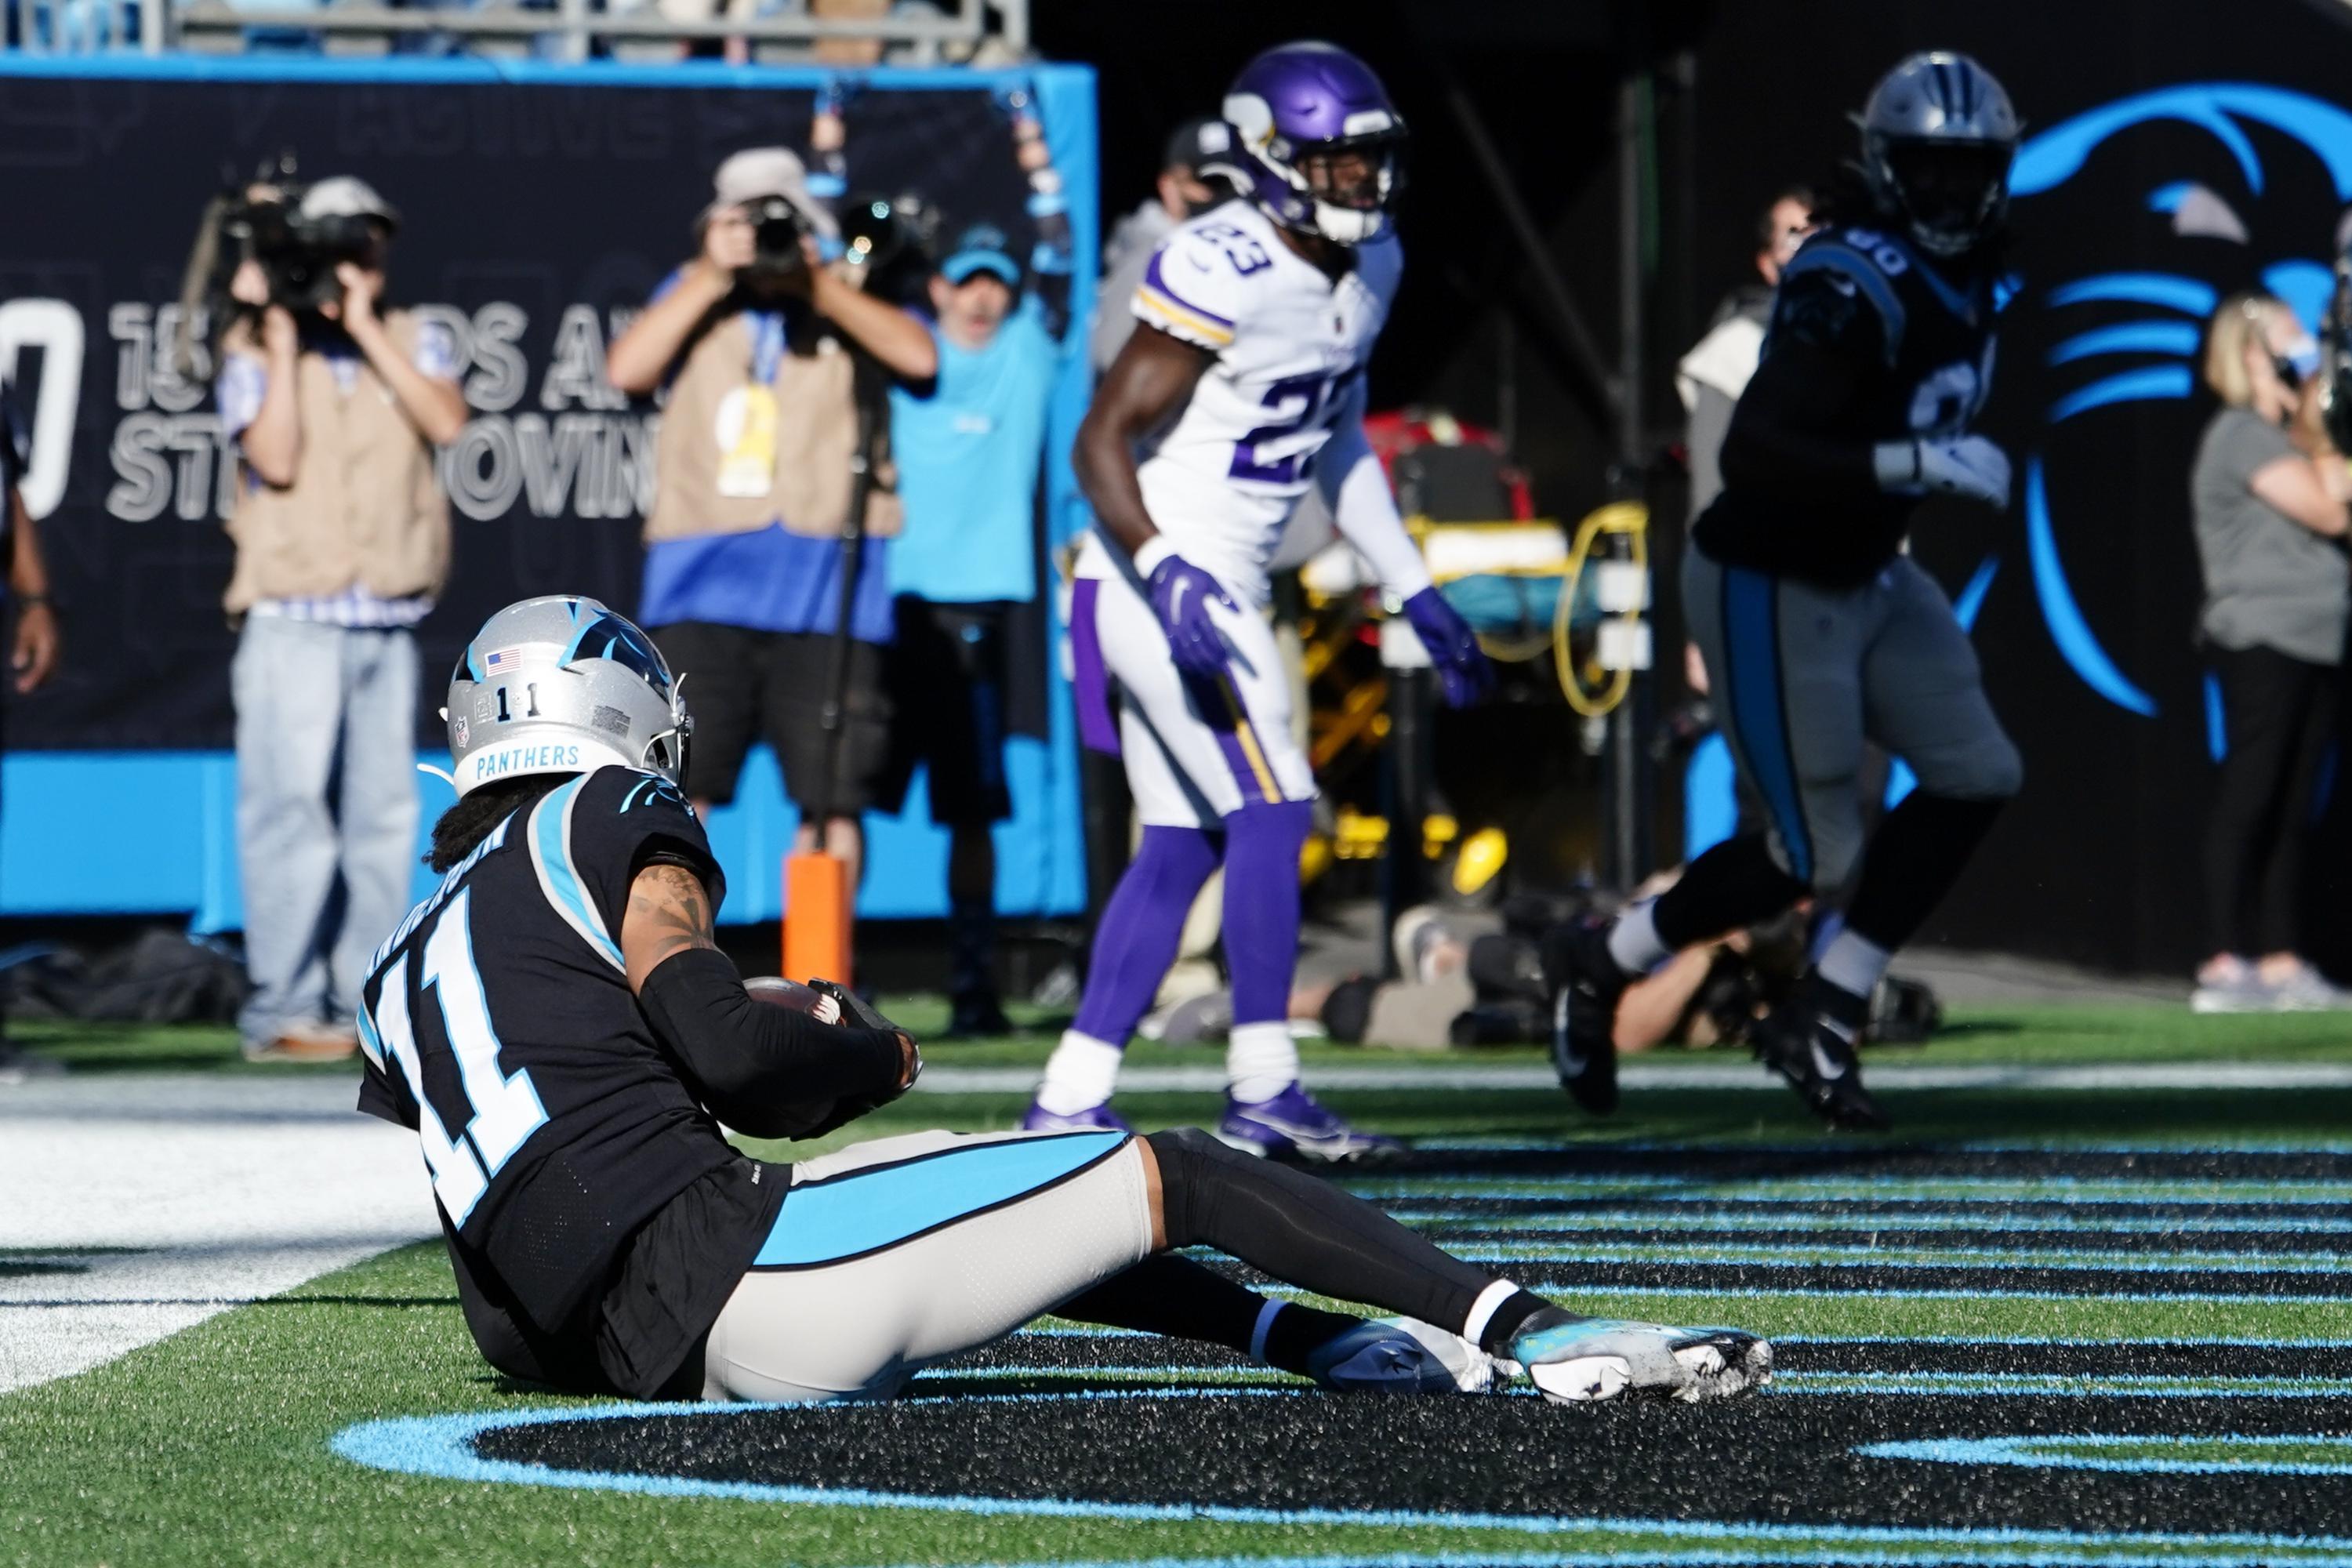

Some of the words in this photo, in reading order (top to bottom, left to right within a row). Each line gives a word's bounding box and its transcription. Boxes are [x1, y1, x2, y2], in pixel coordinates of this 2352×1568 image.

[437, 412, 661, 521] OVIN
[477, 746, 579, 780] PANTHERS
[375, 884, 550, 1232] 11
